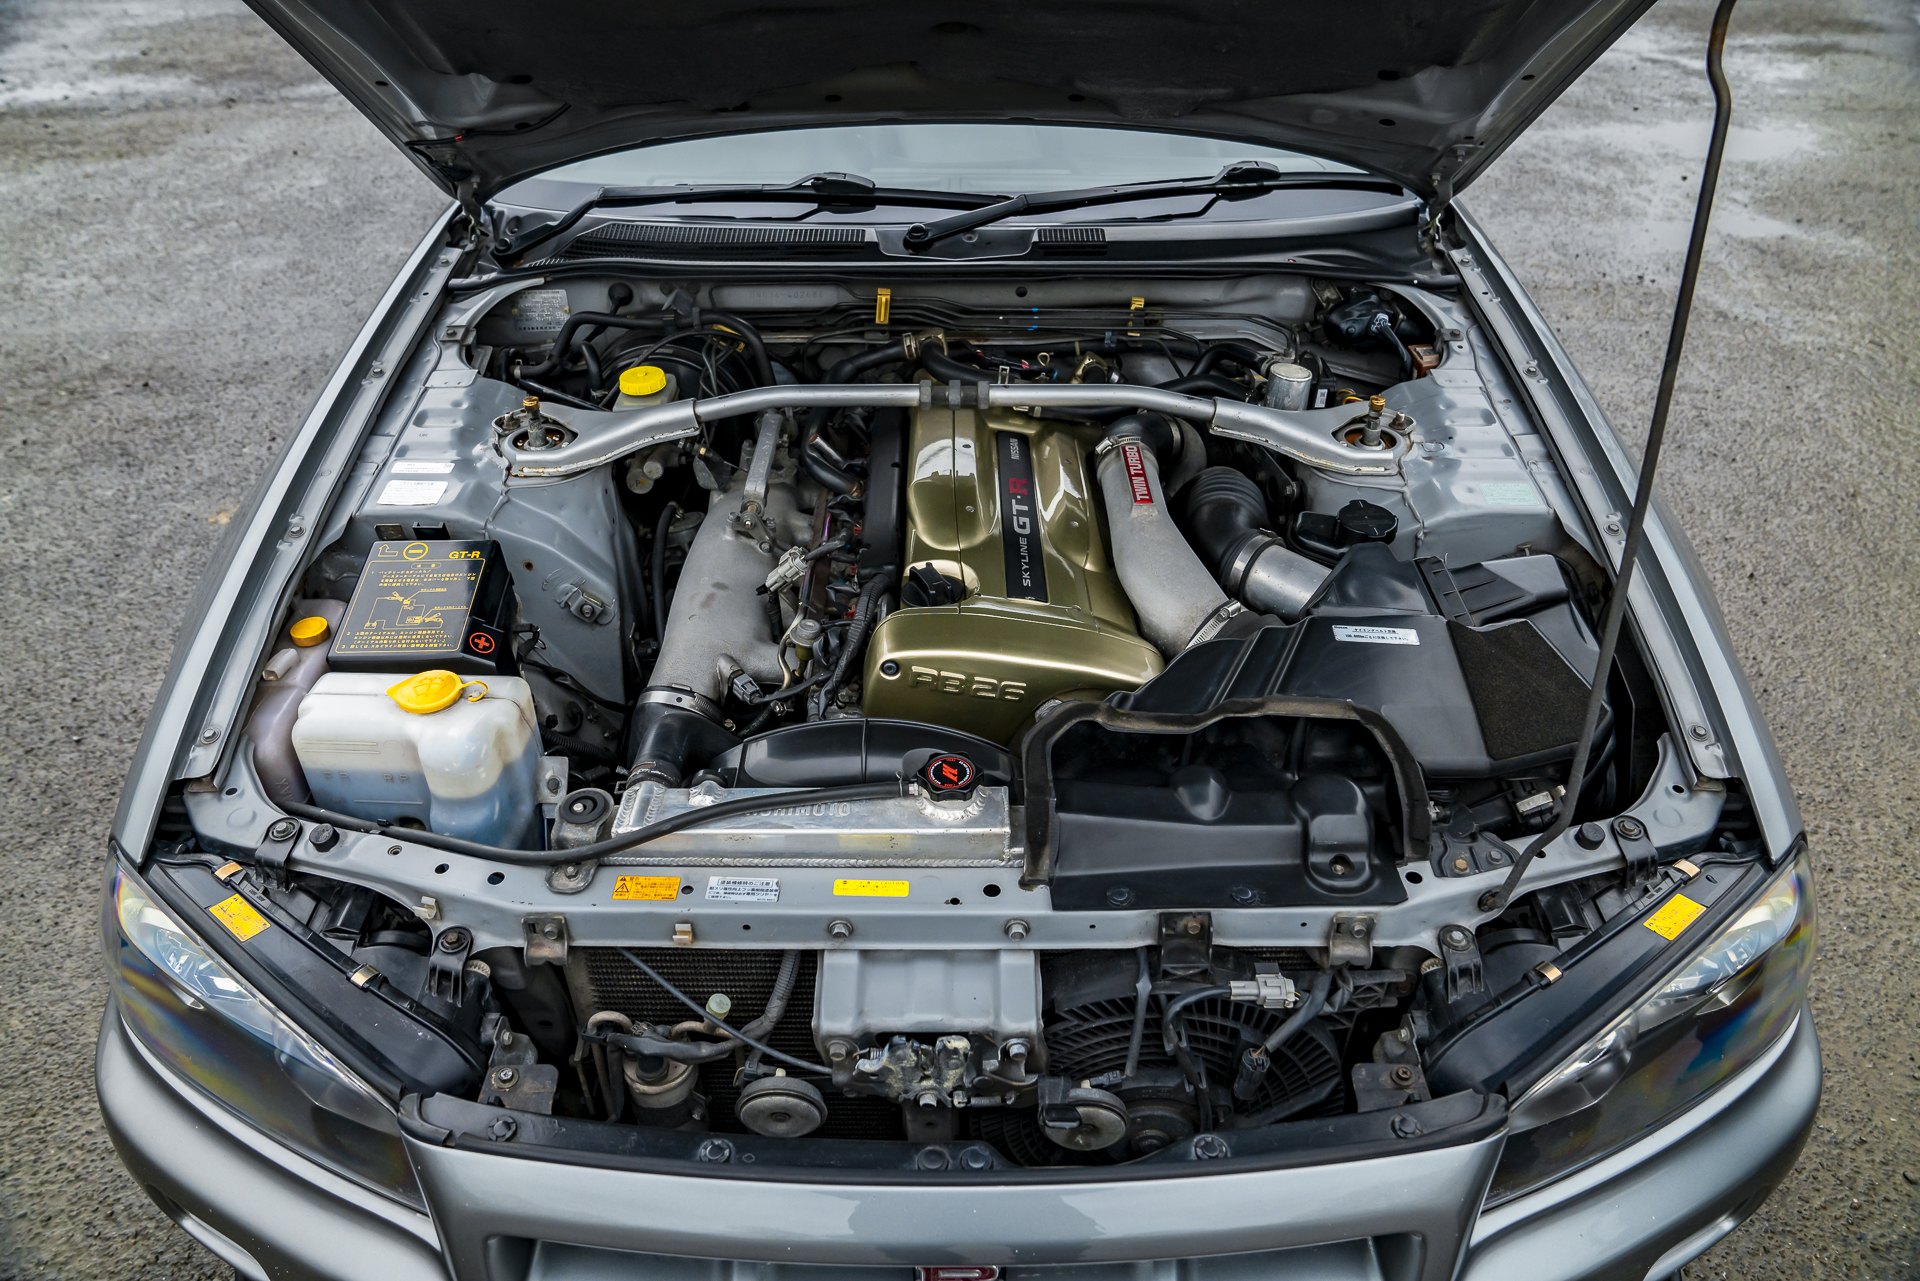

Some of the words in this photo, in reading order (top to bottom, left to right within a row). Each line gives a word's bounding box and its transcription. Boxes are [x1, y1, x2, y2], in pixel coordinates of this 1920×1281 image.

[1009, 438, 1020, 461] NISSAN
[1126, 445, 1143, 474] TURBO
[1133, 476, 1150, 501] TWIN
[449, 550, 481, 559] GT-R
[1019, 537, 1032, 587] SKYLINE
[910, 665, 1027, 701] RB26
